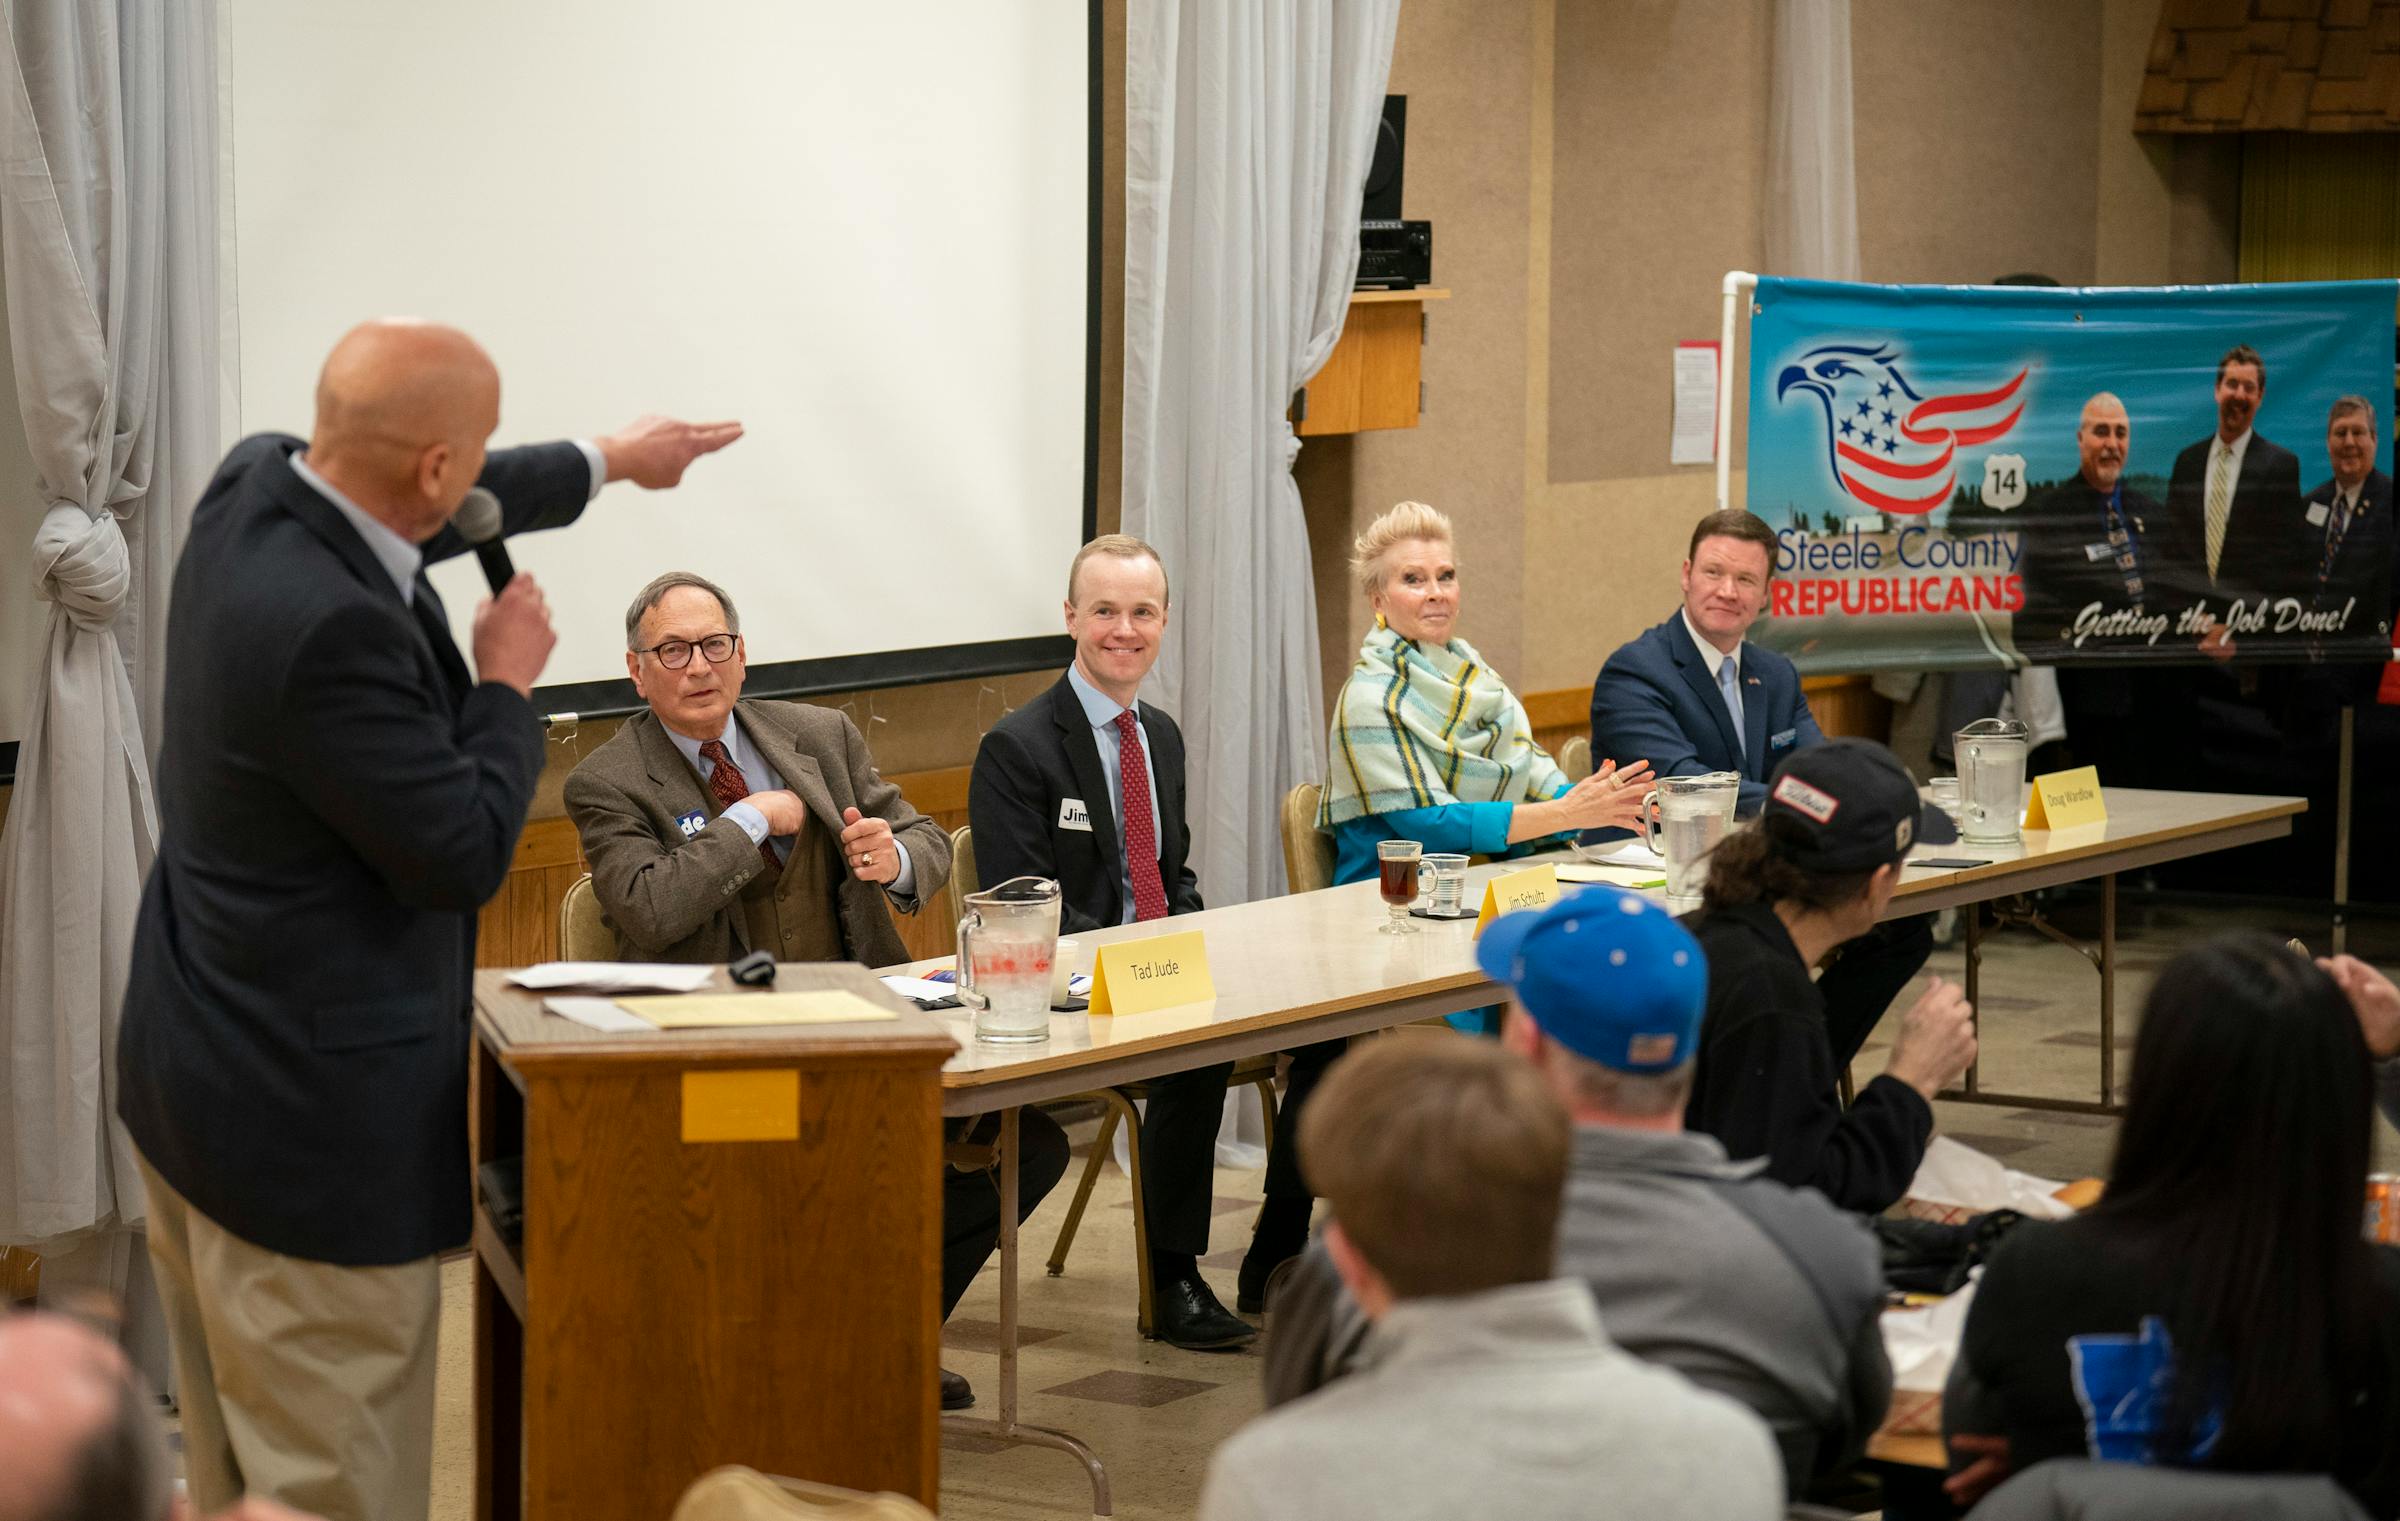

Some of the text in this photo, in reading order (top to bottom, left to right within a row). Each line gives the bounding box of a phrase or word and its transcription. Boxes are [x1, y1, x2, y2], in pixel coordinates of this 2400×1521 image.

[1991, 468, 2019, 496] 14
[1776, 523, 2024, 572] Steele County
[1770, 575, 2026, 617] REPUBLICANS
[2073, 597, 2356, 648] Getting the Job Done!
[2047, 794, 2067, 808] Doug
[1063, 808, 1089, 823] Jim
[1509, 889, 1546, 911] Jim Schultz
[1130, 959, 1180, 981] Tad Jude
